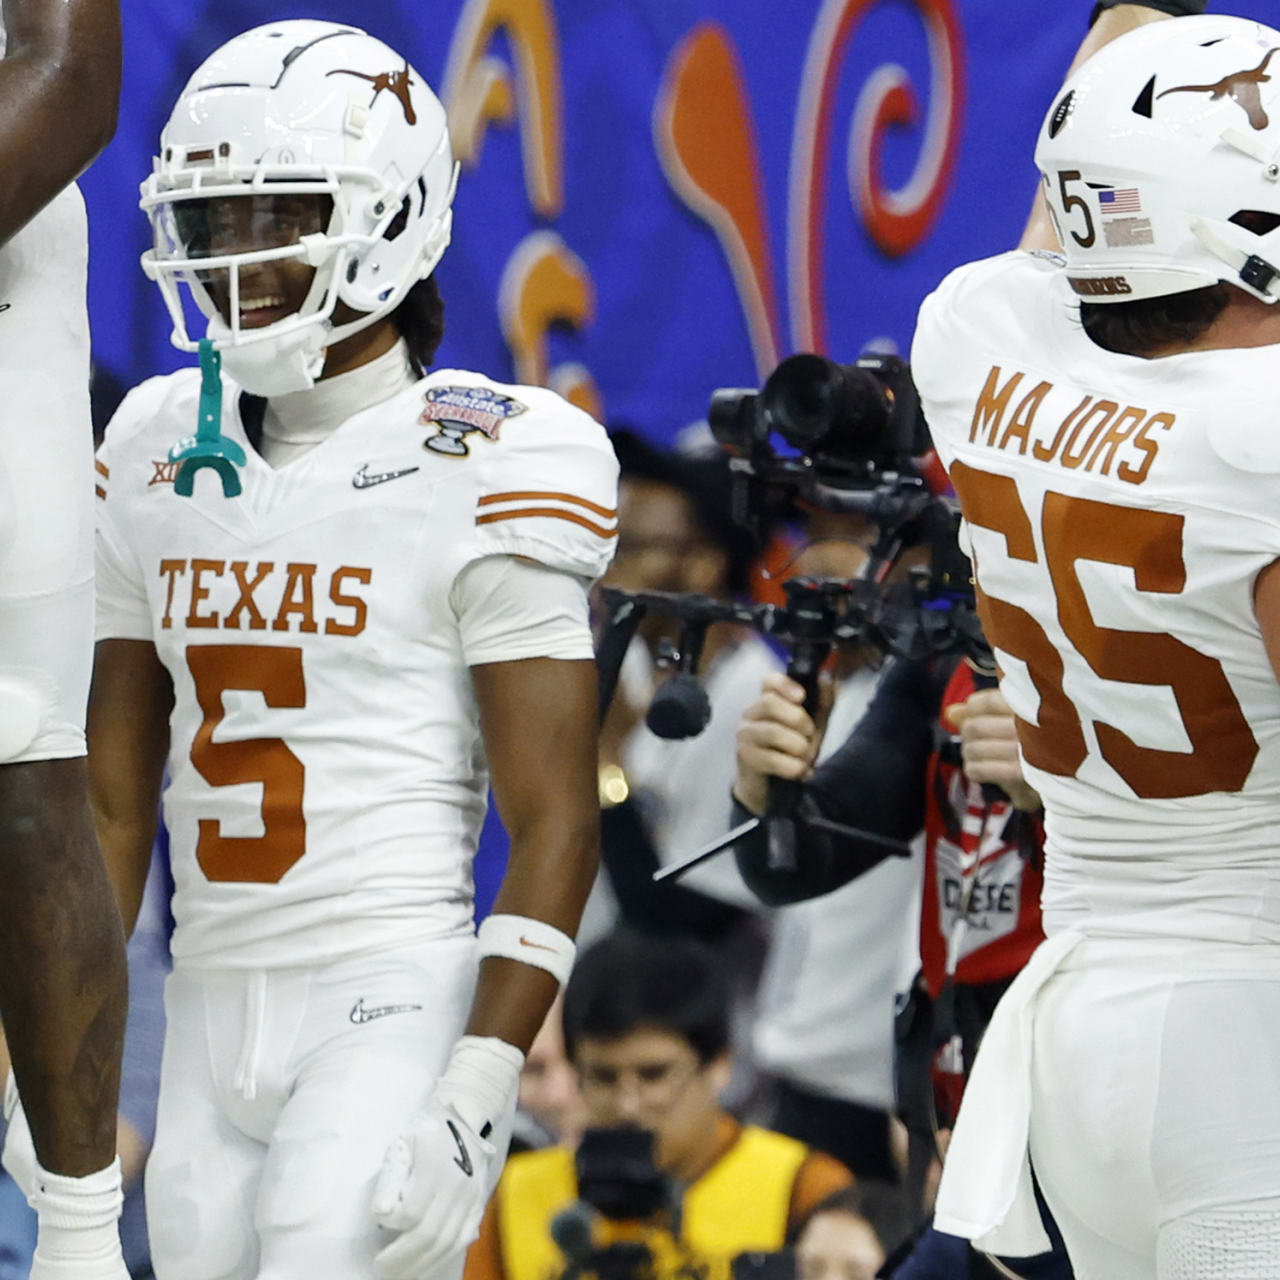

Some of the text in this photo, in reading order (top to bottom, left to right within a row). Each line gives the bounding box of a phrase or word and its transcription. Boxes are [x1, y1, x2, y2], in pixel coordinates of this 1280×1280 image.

[1042, 170, 1096, 249] 5
[969, 365, 1176, 485] MAJORS
[159, 558, 372, 637] TEXAS
[949, 459, 1259, 799] 65
[185, 644, 307, 884] 5
